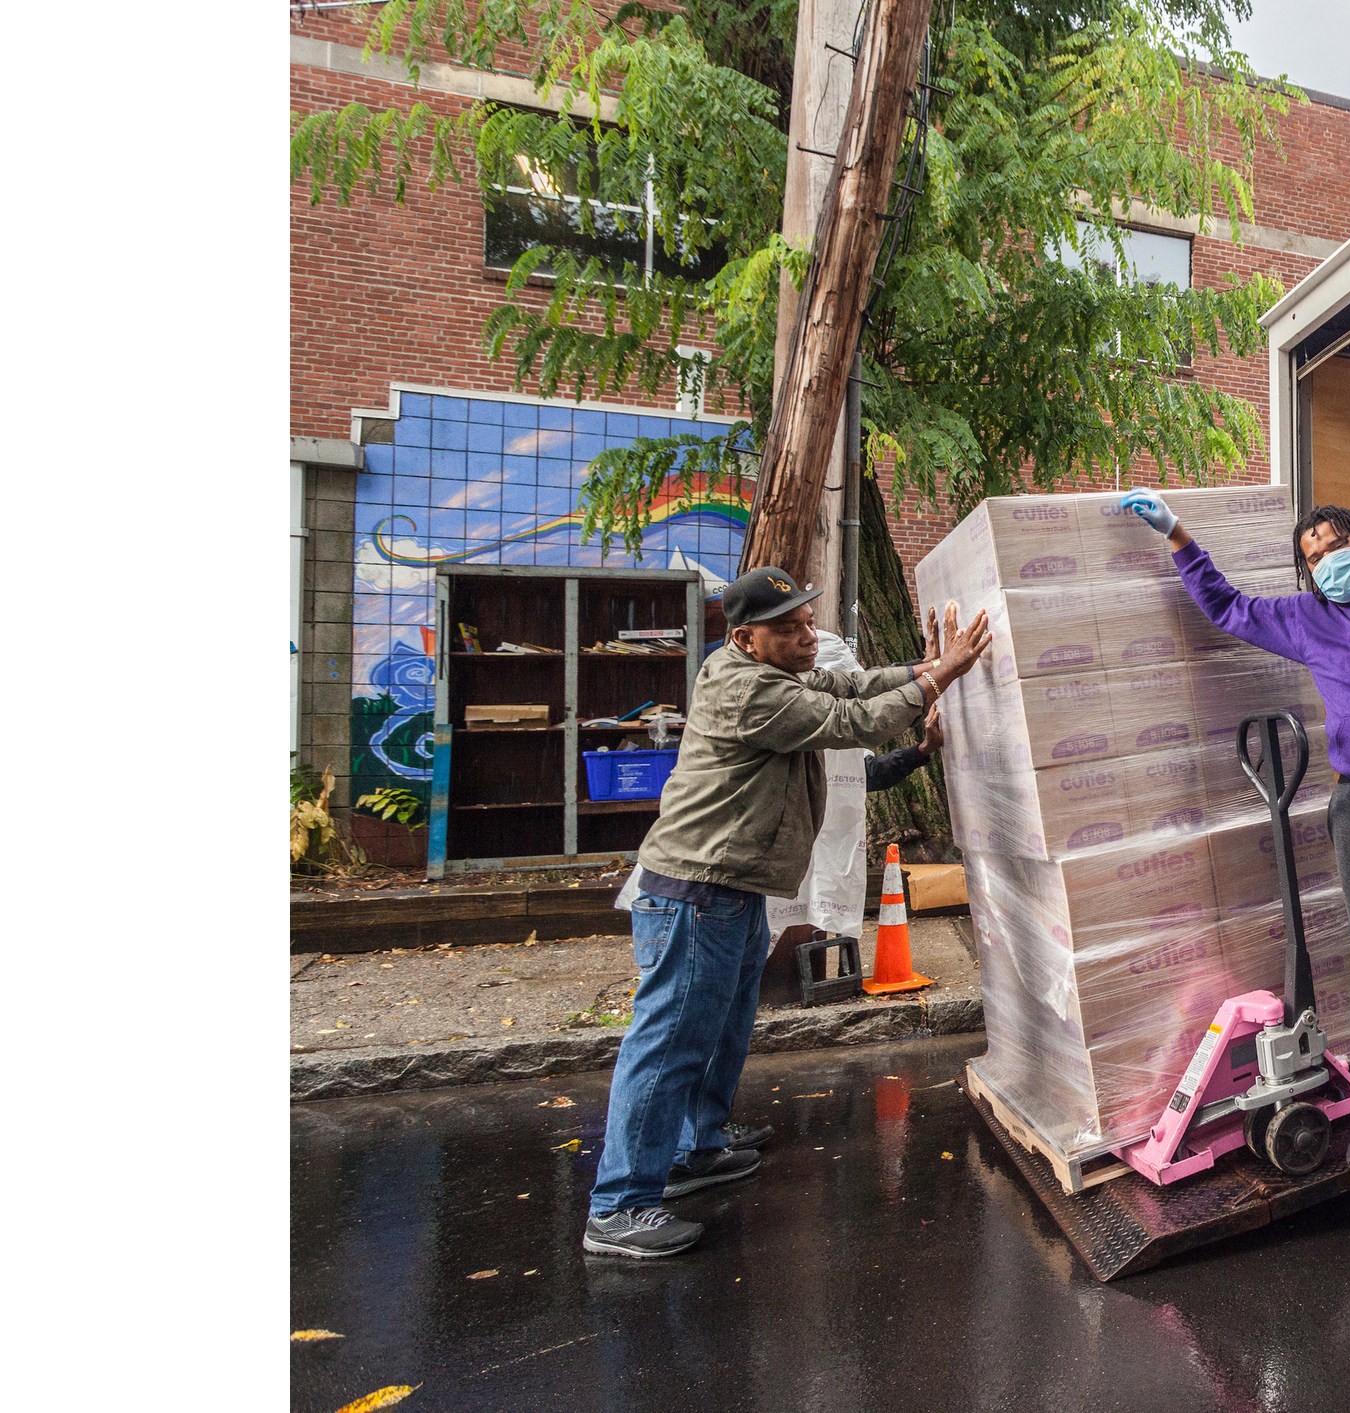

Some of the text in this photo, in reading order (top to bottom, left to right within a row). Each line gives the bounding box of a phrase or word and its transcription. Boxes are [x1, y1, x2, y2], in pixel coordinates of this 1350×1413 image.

[1012, 503, 1070, 521] cuties
[1060, 769, 1116, 791] cuties
[1259, 820, 1328, 854] cies
[1117, 848, 1196, 881] cuties
[1128, 939, 1208, 974] cuties
